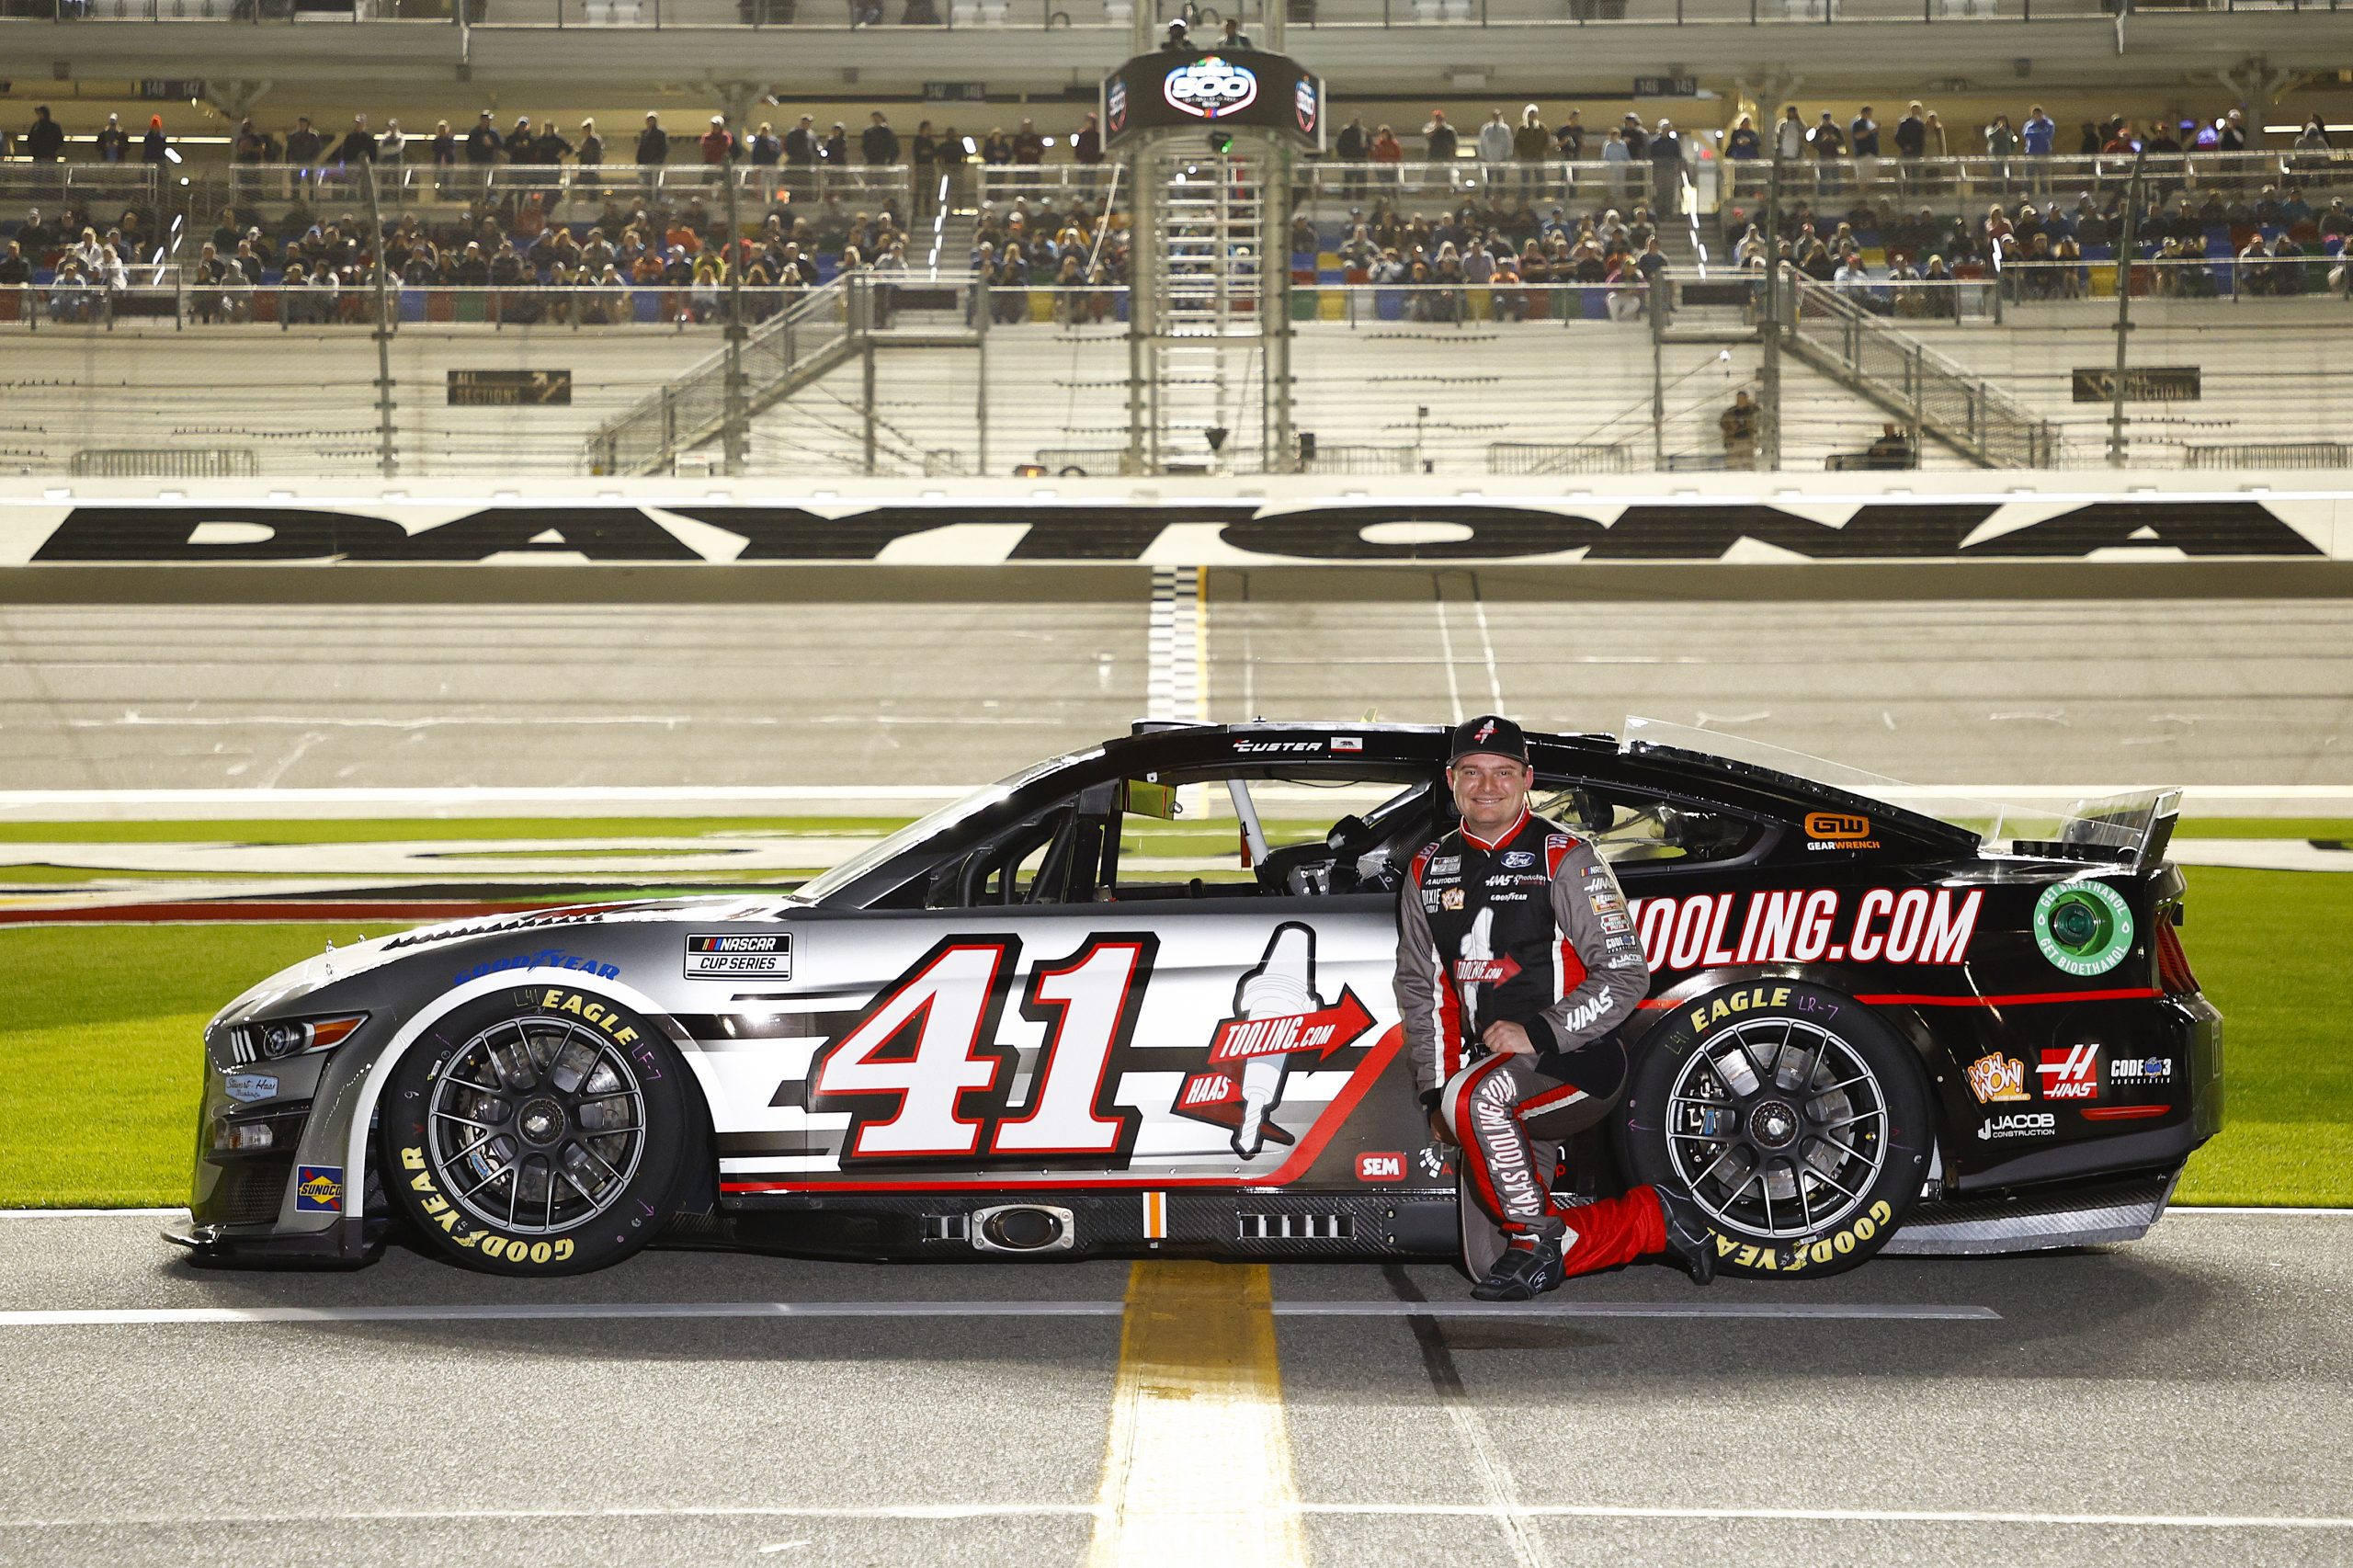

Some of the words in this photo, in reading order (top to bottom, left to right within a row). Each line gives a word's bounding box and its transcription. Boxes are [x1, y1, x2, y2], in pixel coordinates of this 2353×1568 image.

[1172, 76, 1250, 97] 500
[29, 503, 2331, 563] DAYTONA
[1233, 740, 1324, 753] CUSTER
[1807, 840, 1881, 851] GEARWRENCH
[1505, 854, 1531, 866] Ford
[1432, 876, 1462, 885] AUTODESK
[1485, 874, 1514, 887] HAAS
[1422, 888, 1442, 905] DIXIE
[1491, 892, 1528, 902] GOODYEAR
[2040, 887, 2059, 908] GET
[1628, 888, 1985, 974] OOLING.COM
[720, 937, 777, 951] NASCAR
[700, 958, 728, 970] CUP
[729, 958, 777, 970] SERIES
[1617, 953, 1643, 963] JACOB
[2040, 937, 2060, 959] GET
[2057, 945, 2129, 975] BIOETHANOL
[454, 949, 621, 985] GOODYEAR
[541, 989, 640, 1047] EAGLE
[1564, 985, 1615, 1033] HAAS
[1690, 987, 1792, 1034] EAGLE
[1226, 1016, 1336, 1058] TOOLING.COM
[815, 941, 1142, 1158] 41
[2110, 1059, 2144, 1077] CODE
[2162, 1058, 2172, 1076] 3
[1185, 1074, 1232, 1105] HAAS
[2043, 1082, 2097, 1098] HAAS
[1992, 1113, 2055, 1131] JACOB
[1993, 1128, 2055, 1139] CONSTRUCTION
[1362, 1157, 1400, 1176] SEM
[300, 1184, 343, 1197] SUNOCO
[401, 1146, 575, 1264] GOODYEAR
[1707, 1200, 1893, 1271] GOODYEA
